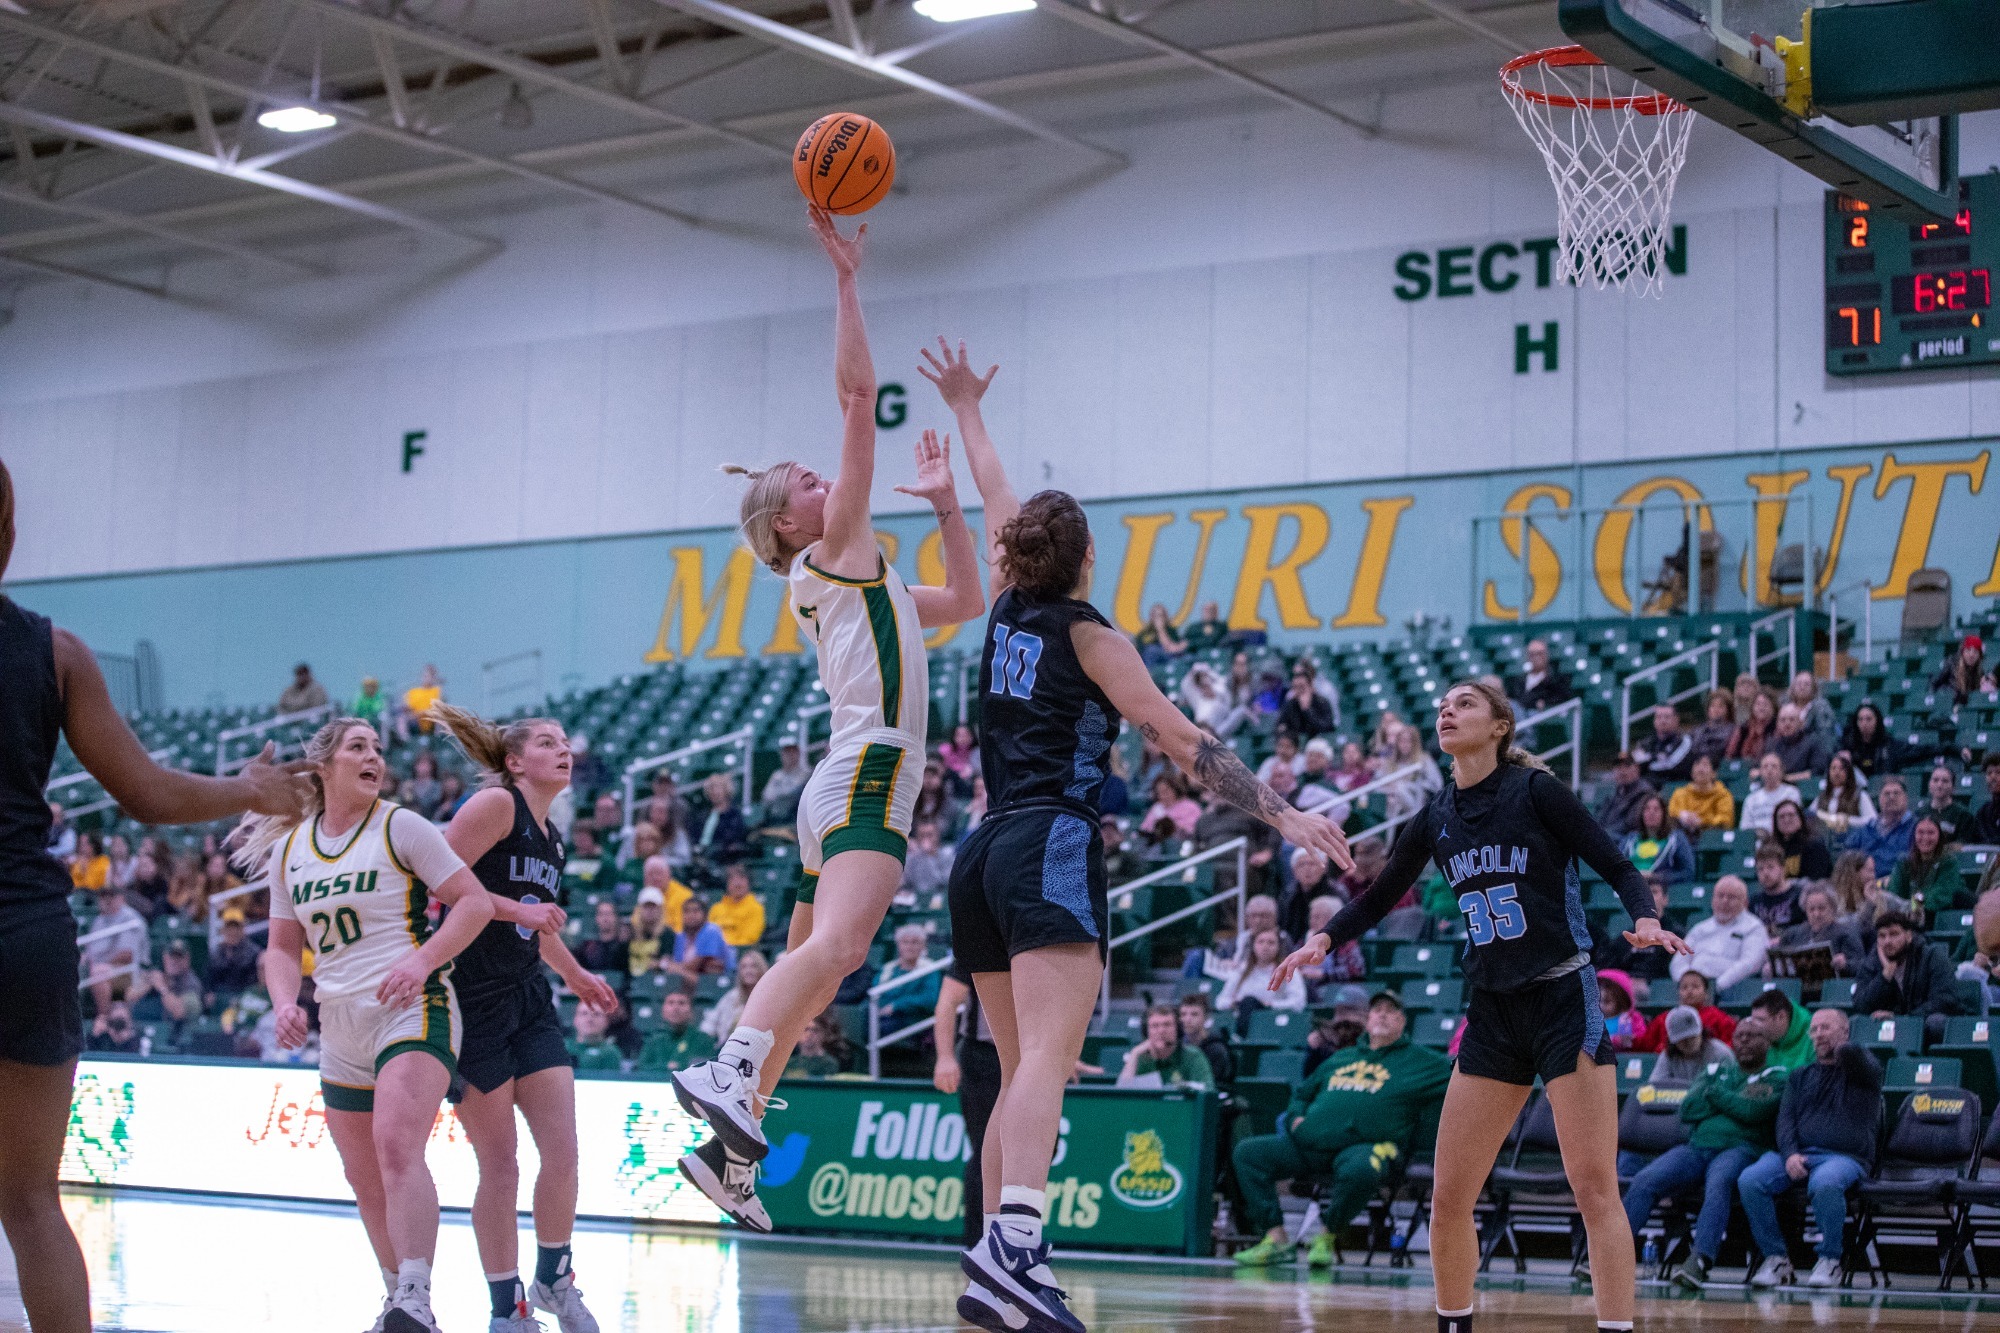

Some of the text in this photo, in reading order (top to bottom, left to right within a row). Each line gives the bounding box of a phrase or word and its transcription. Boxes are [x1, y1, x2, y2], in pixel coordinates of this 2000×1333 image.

[817, 120, 861, 178] Wilson
[1851, 216, 1869, 248] 2
[1914, 268, 1991, 313] 6:27
[1514, 320, 1560, 374] H
[1838, 307, 1882, 347] 71
[1918, 335, 1965, 361] period
[875, 383, 908, 430] G
[401, 429, 429, 474] F
[644, 450, 2000, 664] MSURI SOUT
[990, 622, 1043, 700] 10
[292, 870, 378, 906] MSSU
[509, 855, 561, 898] LINCOL
[1442, 845, 1528, 888] LINCOLN
[310, 905, 363, 955] 20
[1458, 882, 1528, 946] 35
[851, 1100, 974, 1163] Follo
[808, 1161, 1103, 1229] @mosorts
